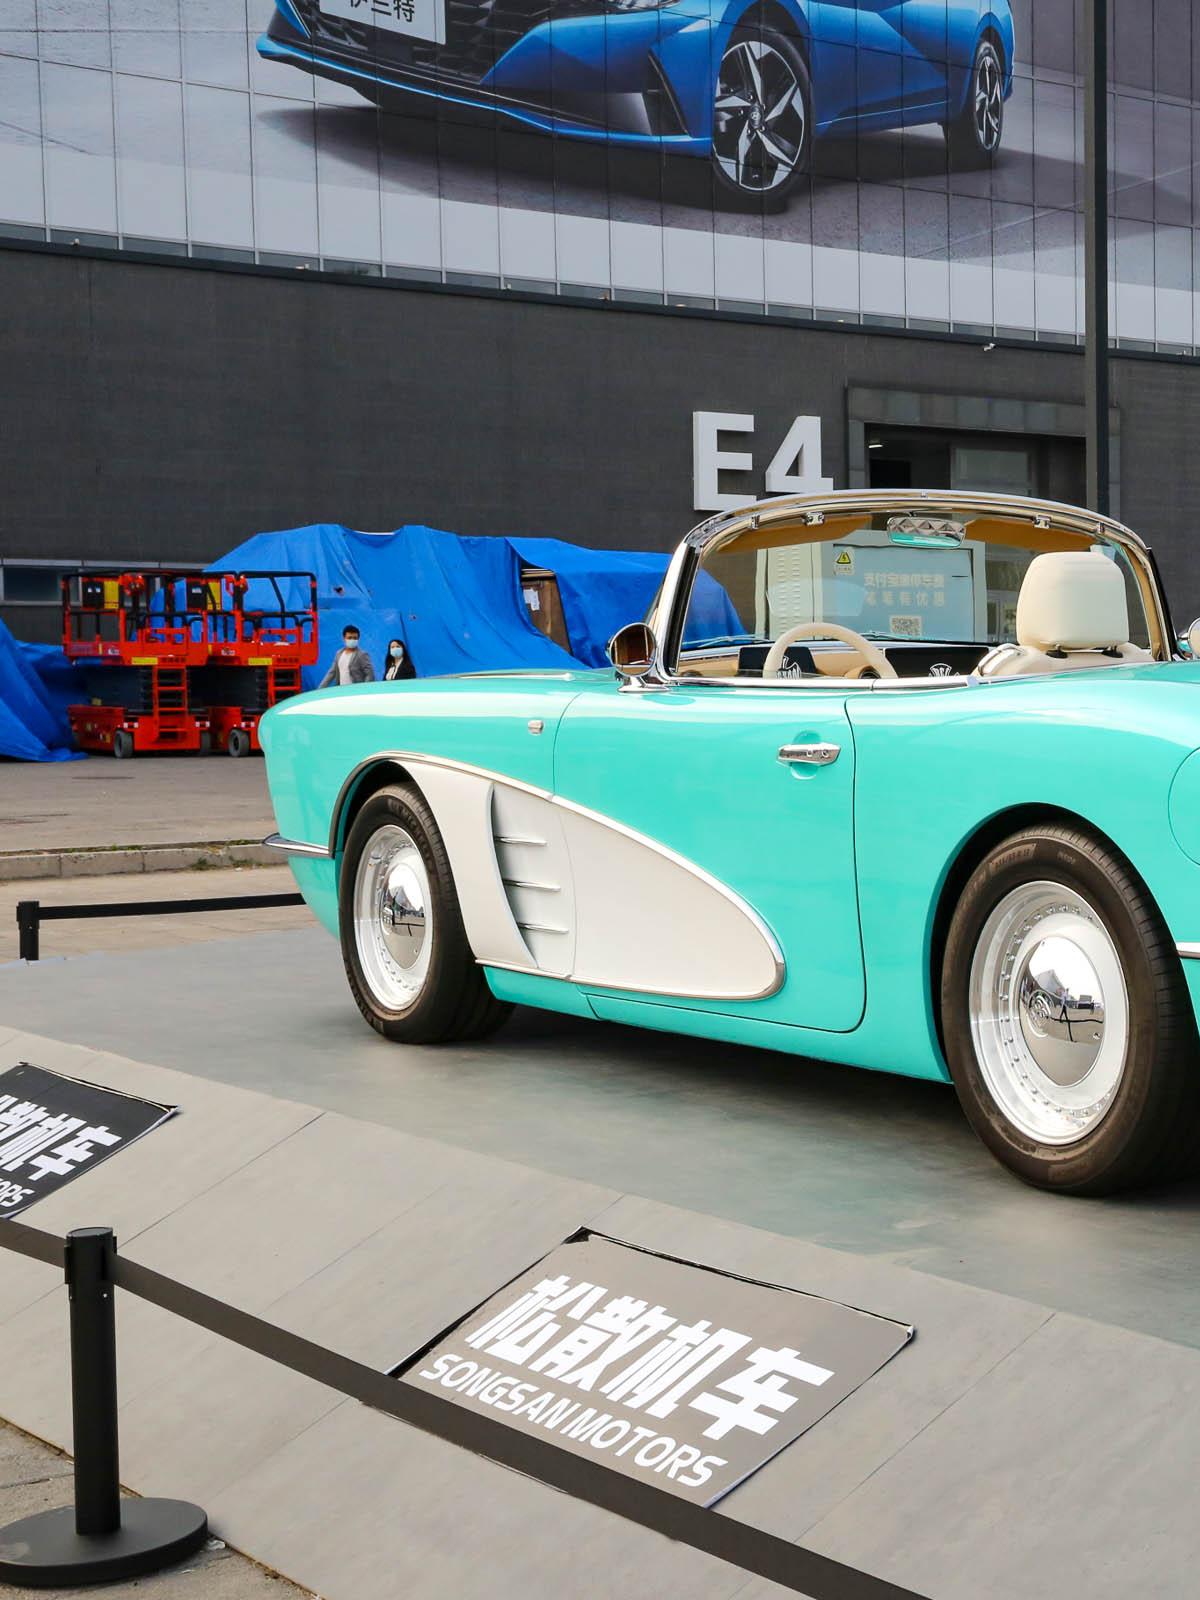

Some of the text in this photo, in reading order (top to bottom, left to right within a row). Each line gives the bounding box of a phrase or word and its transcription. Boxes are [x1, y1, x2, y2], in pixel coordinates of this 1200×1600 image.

[693, 411, 834, 511] E4
[419, 1353, 729, 1487] SONGSAN MOTORS
[464, 1274, 836, 1441] 松散机车
